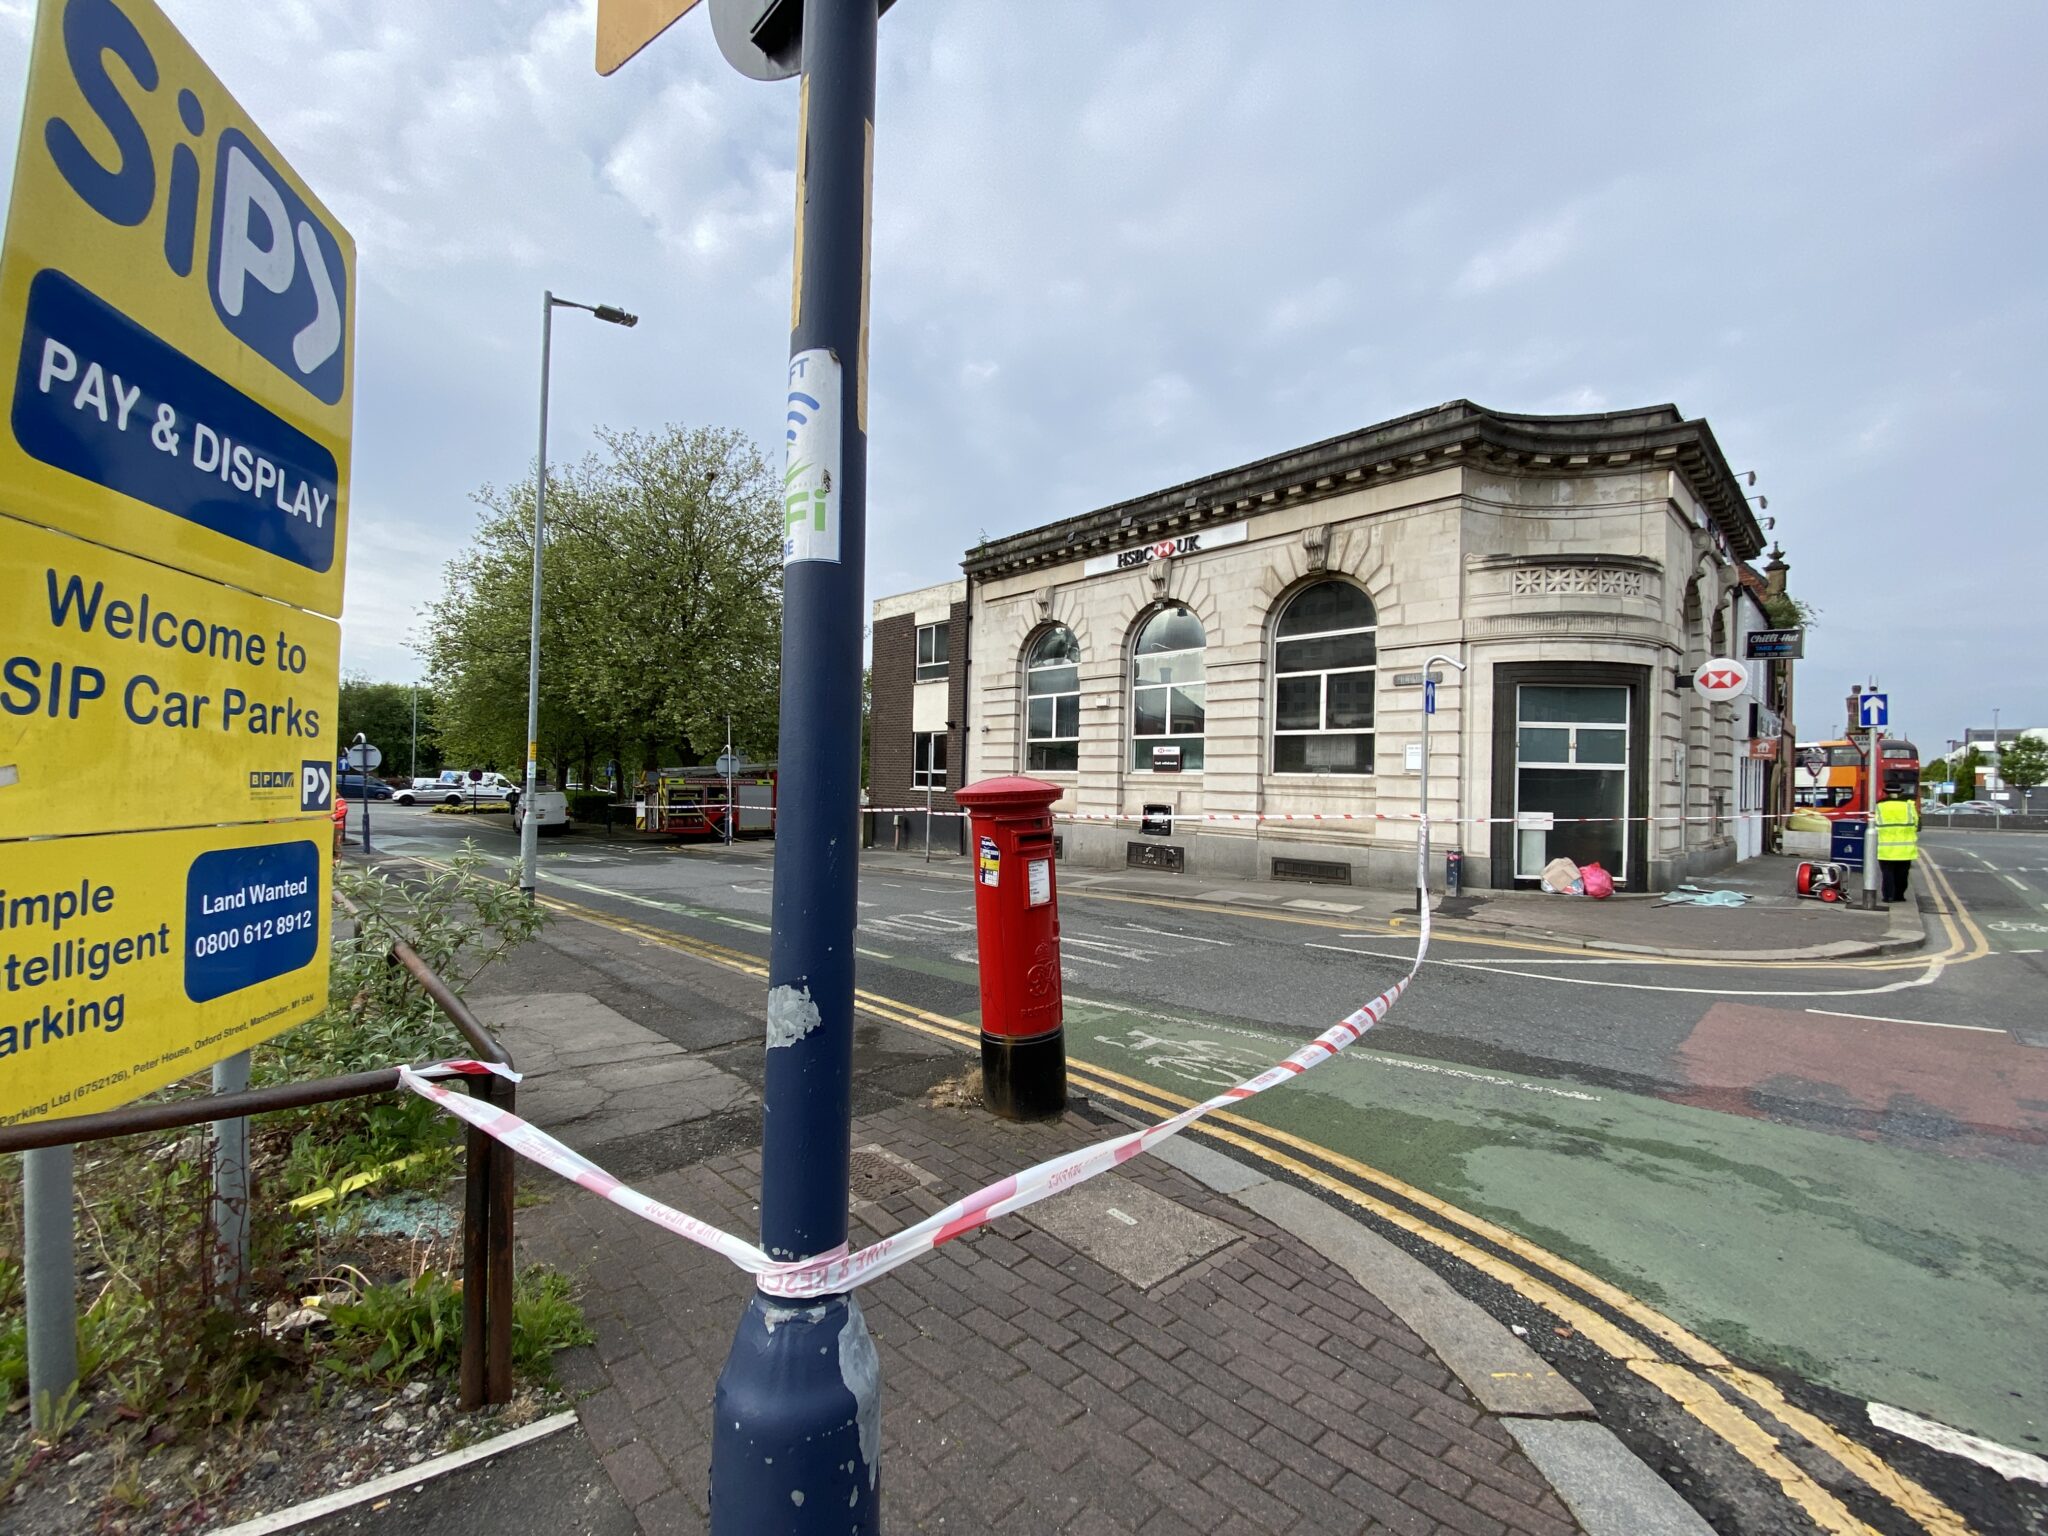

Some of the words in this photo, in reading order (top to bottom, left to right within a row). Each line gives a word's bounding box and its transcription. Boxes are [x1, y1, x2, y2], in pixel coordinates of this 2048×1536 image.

[38, 338, 140, 431] PAY
[151, 403, 179, 457] &
[193, 422, 329, 528] DISPLAY
[1117, 546, 1154, 568] HSBC
[1176, 534, 1201, 553] UK
[47, 568, 265, 666] Welcome
[277, 632, 306, 674] to
[0, 656, 105, 719] SIP
[124, 675, 209, 728] Car
[223, 688, 320, 738] Parks
[252, 774, 282, 785] BPA
[203, 888, 246, 915] Land
[249, 876, 308, 905] Wanted
[195, 928, 239, 957] 0800
[243, 920, 273, 944] 612
[276, 910, 312, 935] 8912
[0, 1103, 48, 1126] Parking
[51, 1091, 71, 1108] Ltd
[73, 1070, 131, 1101] (6752126),
[133, 1057, 160, 1075] Peter
[161, 1045, 192, 1064] House,
[194, 1032, 222, 1050] Oxford
[223, 1022, 248, 1039] Street,
[291, 998, 301, 1009] M1
